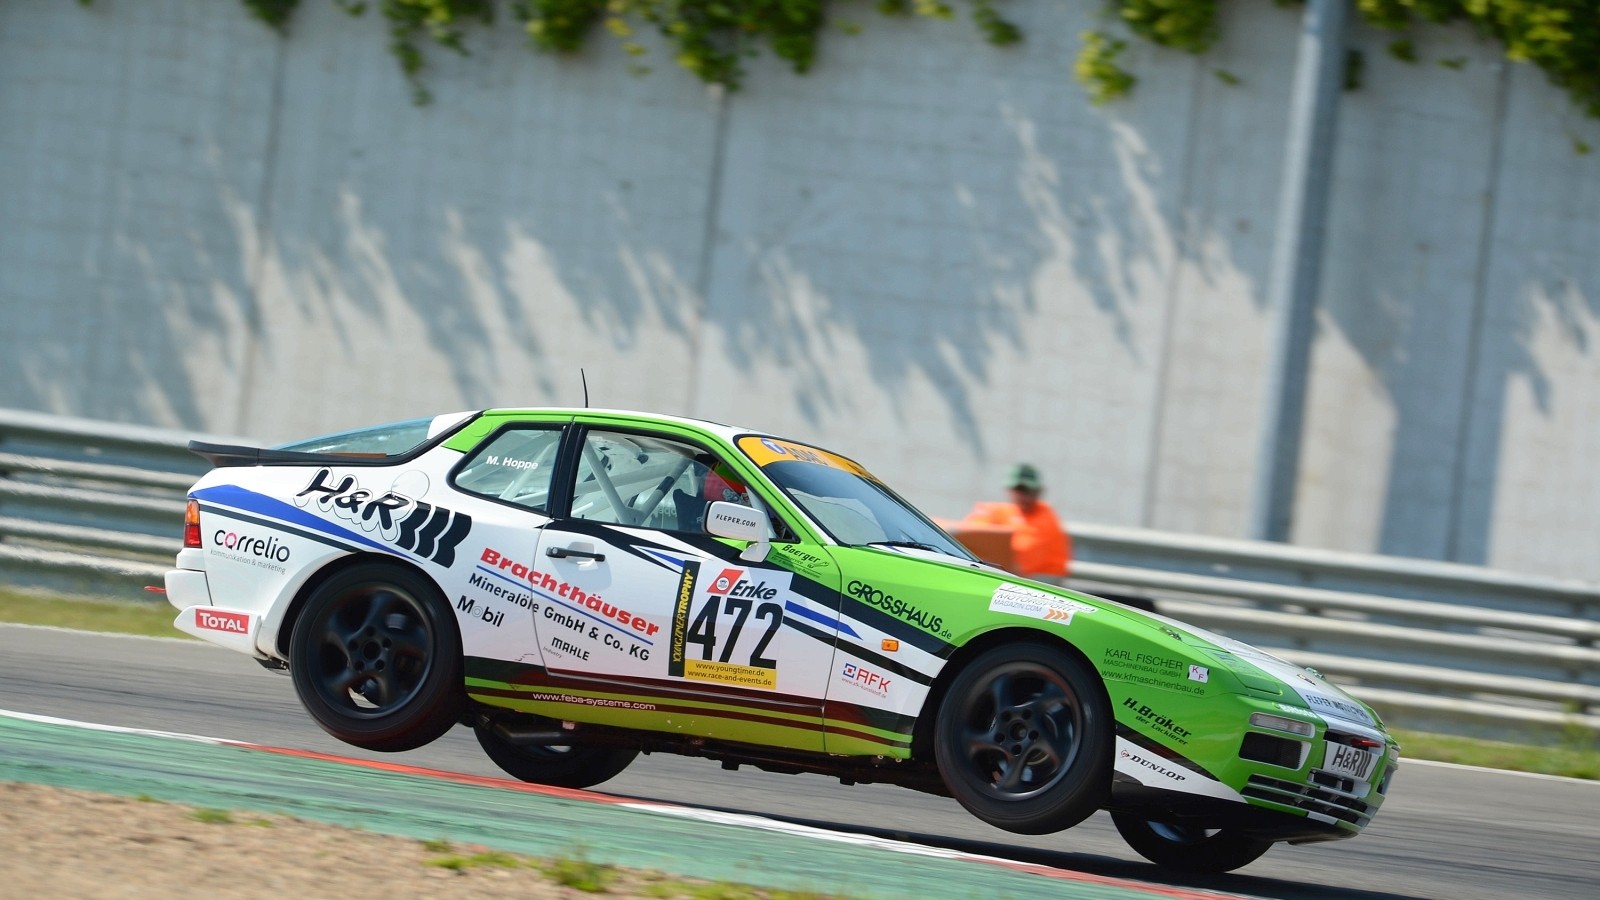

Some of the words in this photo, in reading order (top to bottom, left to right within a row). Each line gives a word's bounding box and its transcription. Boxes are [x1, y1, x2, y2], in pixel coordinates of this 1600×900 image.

[486, 455, 499, 465] M.
[502, 457, 539, 470] Hoppe
[716, 513, 756, 528] FLEPER.COM
[214, 529, 290, 562] correlio
[781, 544, 821, 563] Boerger
[210, 548, 250, 564] kommunikation
[257, 561, 286, 575] marketing
[480, 547, 659, 637] Brachthäuser
[729, 579, 778, 600] Enke
[457, 595, 505, 628] Mobil
[468, 572, 539, 613] Mineralöle
[544, 607, 586, 634] GmbH
[588, 627, 599, 640] &
[603, 633, 623, 651] Co.
[629, 644, 650, 662] KG
[993, 599, 1042, 613] MAGAZIN.COM
[200, 612, 246, 632] TOTAL
[687, 595, 784, 669] 472
[551, 637, 590, 662] MAHLE
[1105, 648, 1133, 660] KARL
[1136, 653, 1184, 670] FISCHER
[688, 670, 772, 686] www.race-and-events.de
[695, 662, 765, 677] www.youngtimer.de
[1103, 659, 1158, 674] MASCHINENBAU
[1159, 669, 1181, 678] GMBH
[1192, 666, 1199, 674] K
[856, 668, 891, 693] AFK
[1101, 669, 1205, 696] www.kfmaschinenbau.de
[532, 692, 656, 710] www.feba-systeme.com
[1123, 697, 1192, 738] H.Bröker
[1135, 715, 1150, 725] der
[1151, 723, 1189, 745] Lackierer
[1130, 755, 1186, 781] DUNLOP
